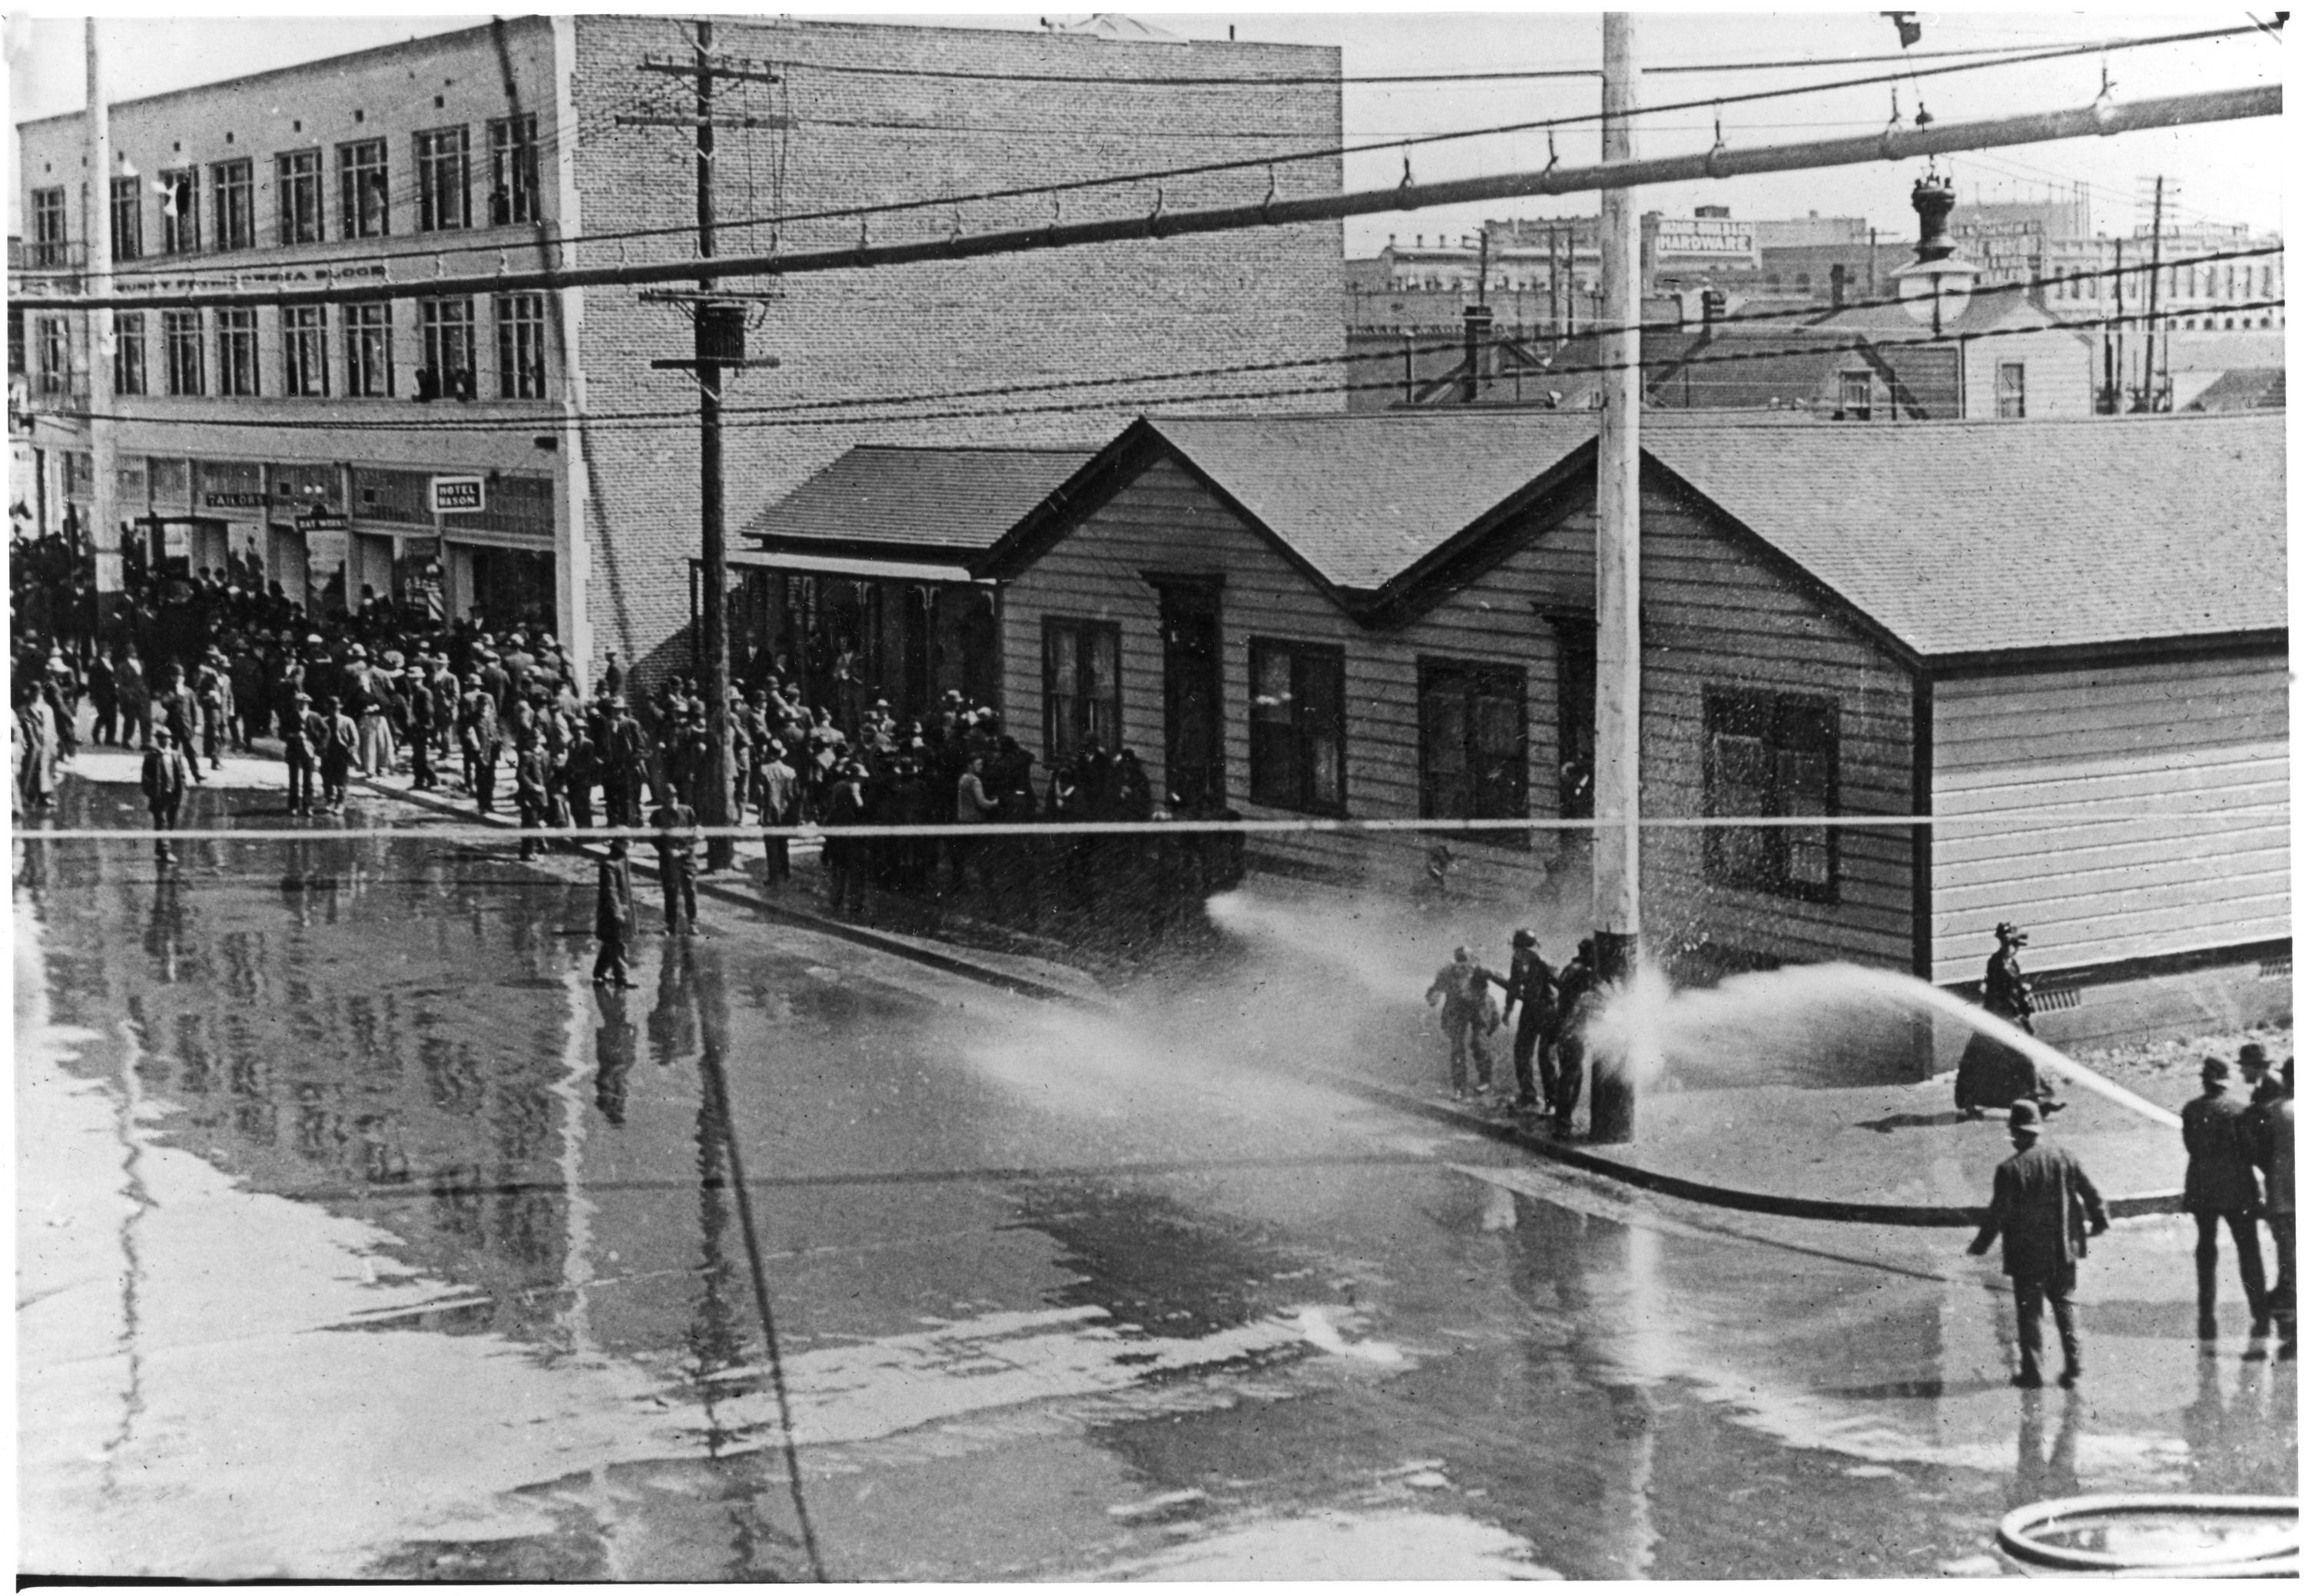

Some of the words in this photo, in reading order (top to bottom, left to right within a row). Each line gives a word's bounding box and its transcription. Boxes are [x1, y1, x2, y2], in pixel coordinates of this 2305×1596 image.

[1659, 234, 1749, 251] HARDWARE
[439, 485, 476, 496] HOTEL
[208, 495, 264, 506] TAILORS
[439, 496, 476, 506] MASON
